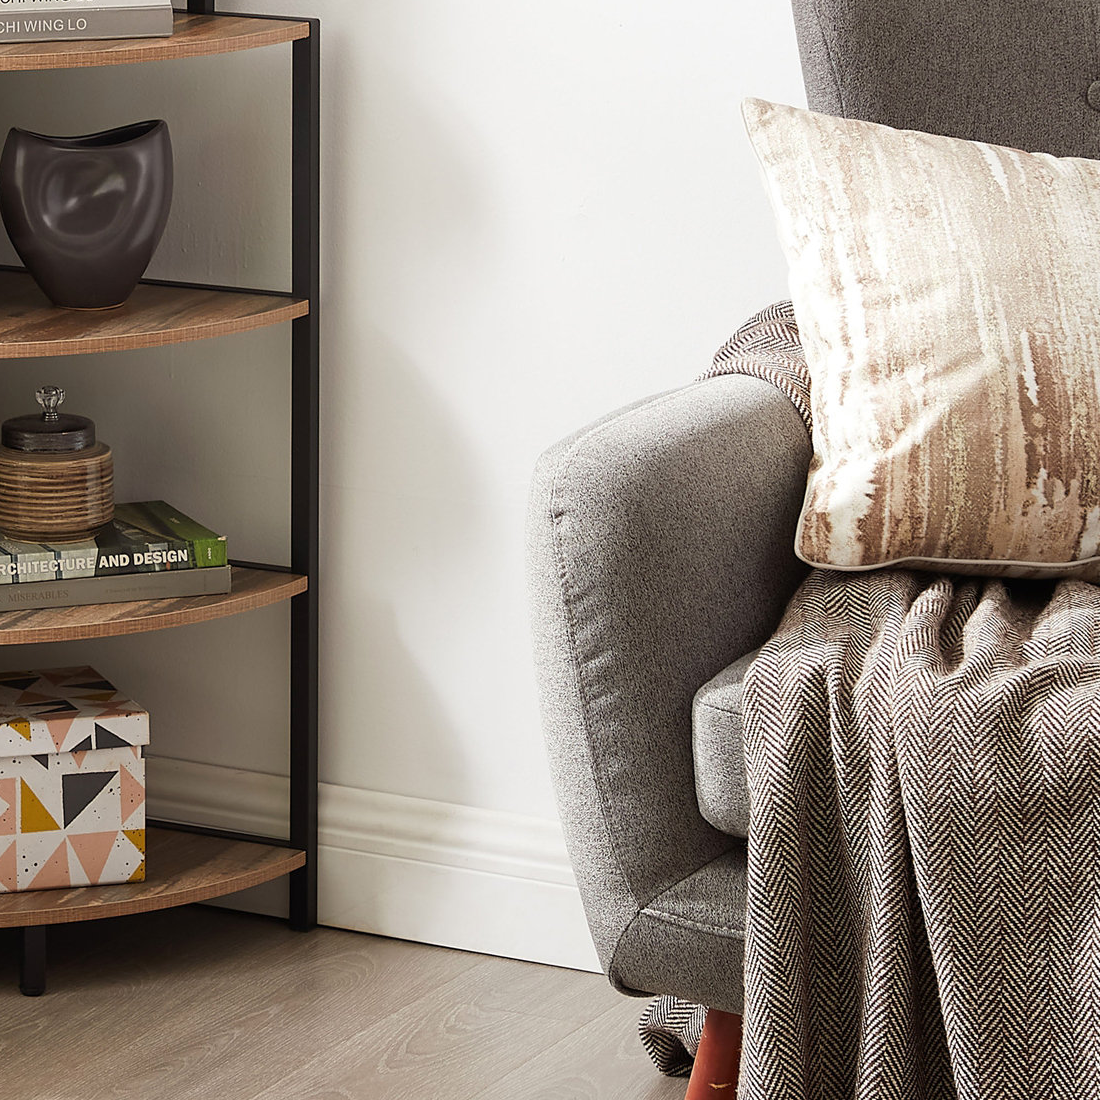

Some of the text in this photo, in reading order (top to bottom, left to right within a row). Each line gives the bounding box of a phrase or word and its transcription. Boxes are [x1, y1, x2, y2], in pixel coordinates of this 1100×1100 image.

[24, 19, 64, 33] WING
[68, 18, 88, 31] LO
[99, 552, 129, 568] AND
[133, 549, 189, 566] DESIGN
